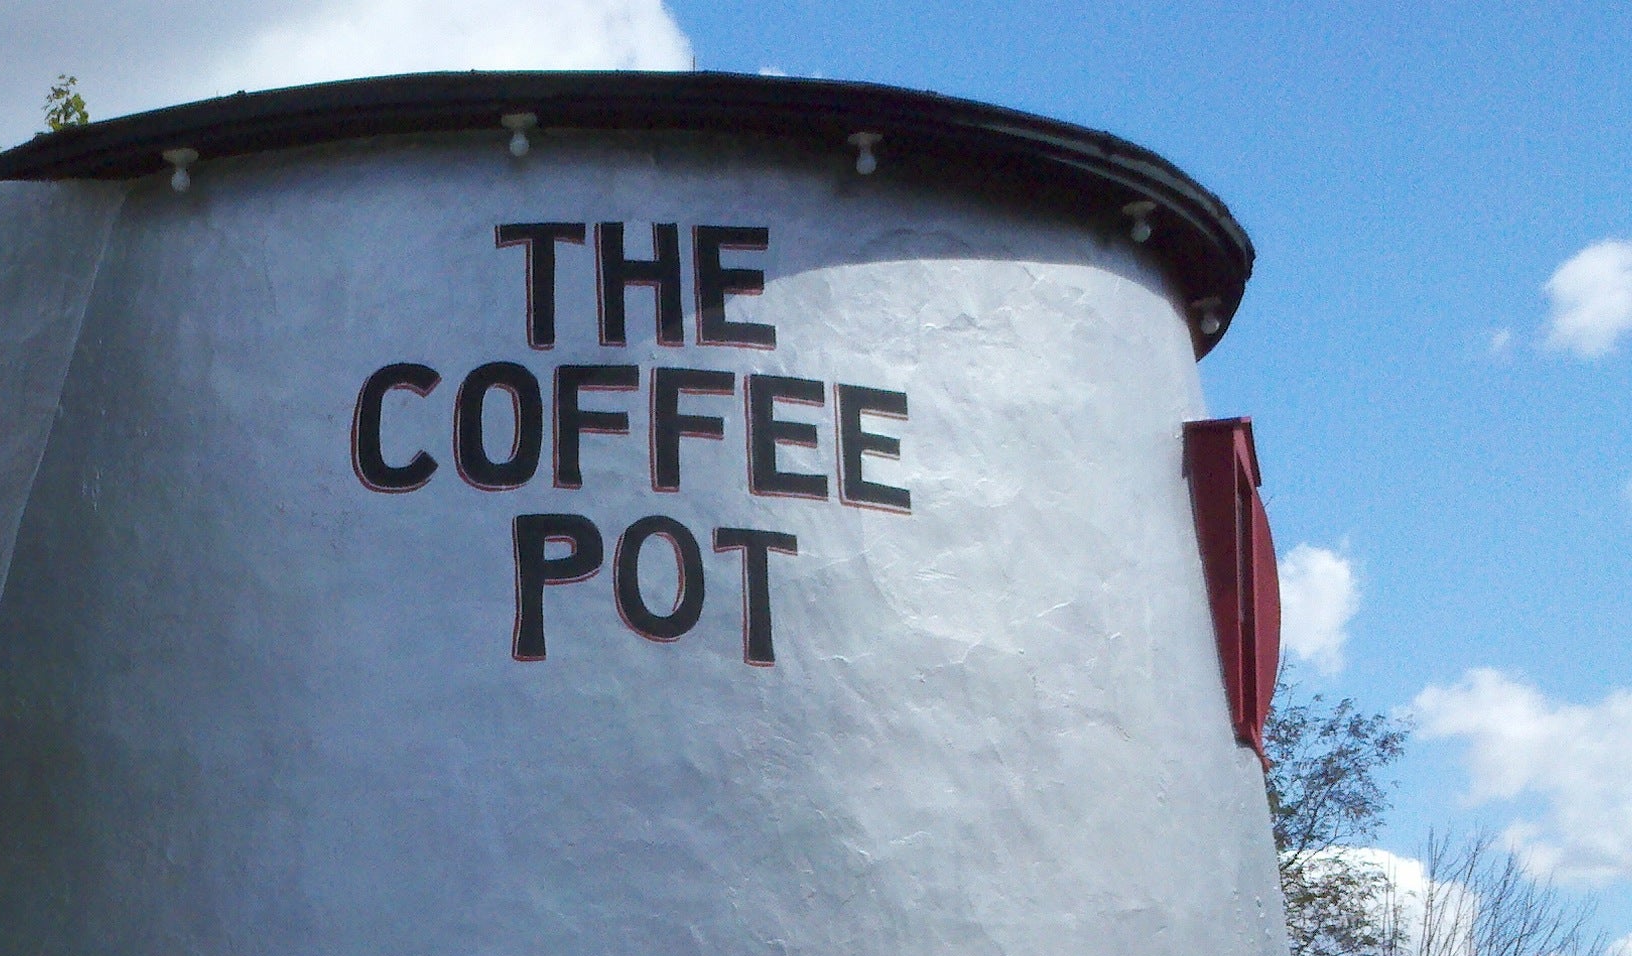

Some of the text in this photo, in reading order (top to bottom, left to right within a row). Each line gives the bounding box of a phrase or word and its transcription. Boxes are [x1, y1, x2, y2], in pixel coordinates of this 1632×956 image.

[494, 221, 777, 350] THE
[350, 360, 912, 515] COFFEE
[511, 513, 798, 667] POT
